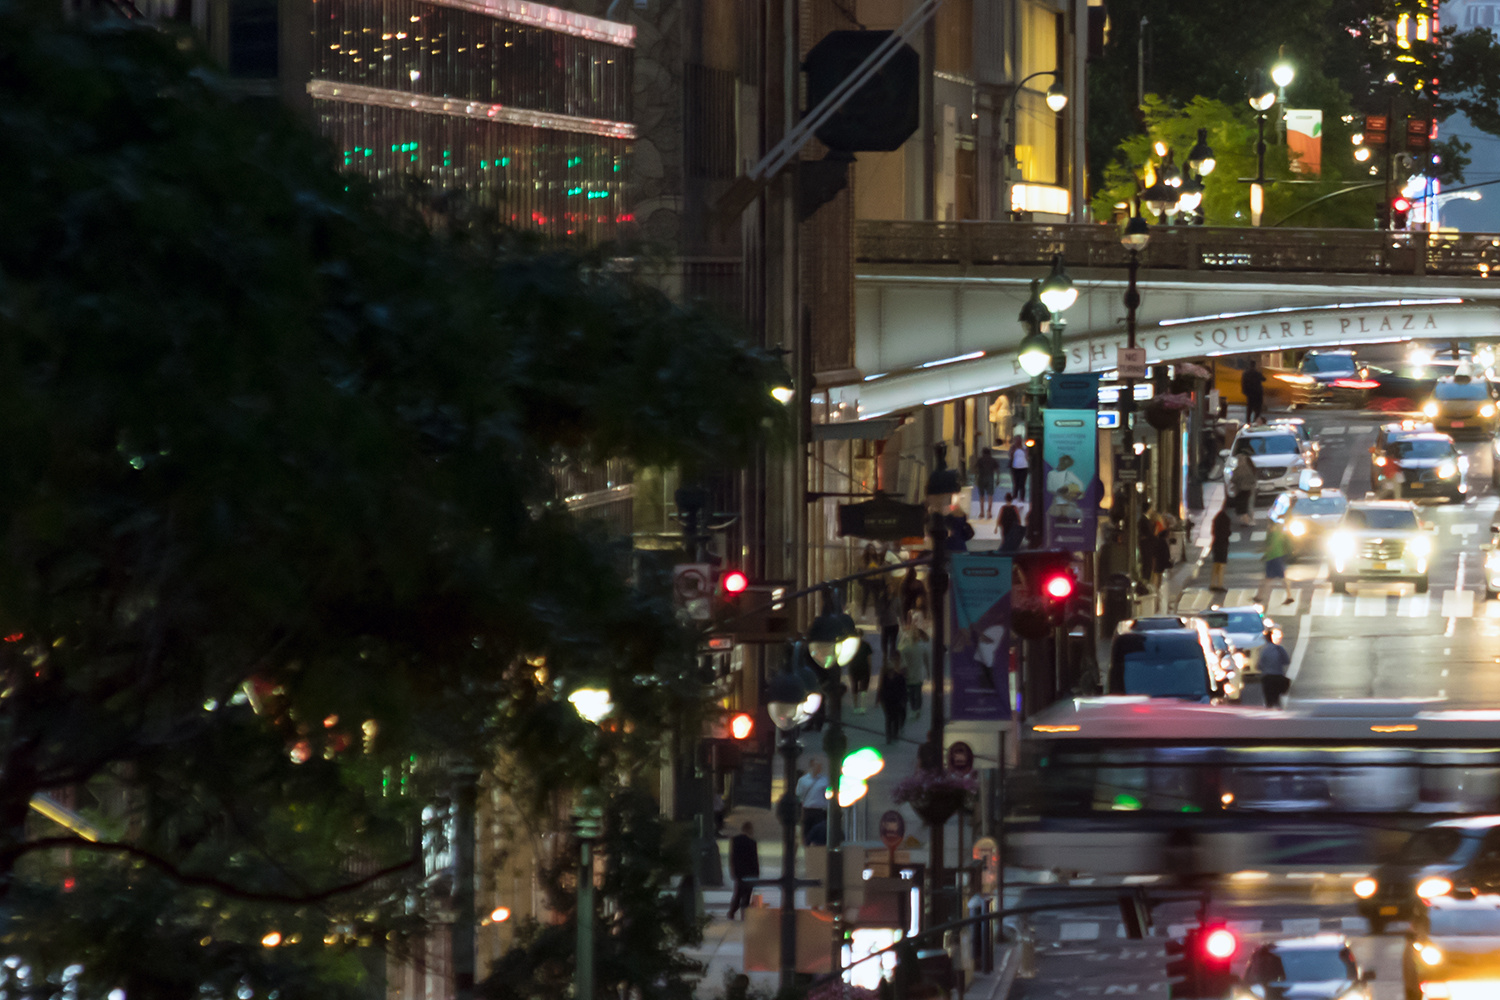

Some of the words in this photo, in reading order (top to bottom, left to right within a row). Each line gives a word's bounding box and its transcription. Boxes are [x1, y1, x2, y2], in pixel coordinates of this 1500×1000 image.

[1011, 335, 1170, 374] PSHNG
[1194, 320, 1314, 348] SQUARE
[1339, 314, 1437, 333] PLAZA
[1125, 353, 1137, 362] NO
